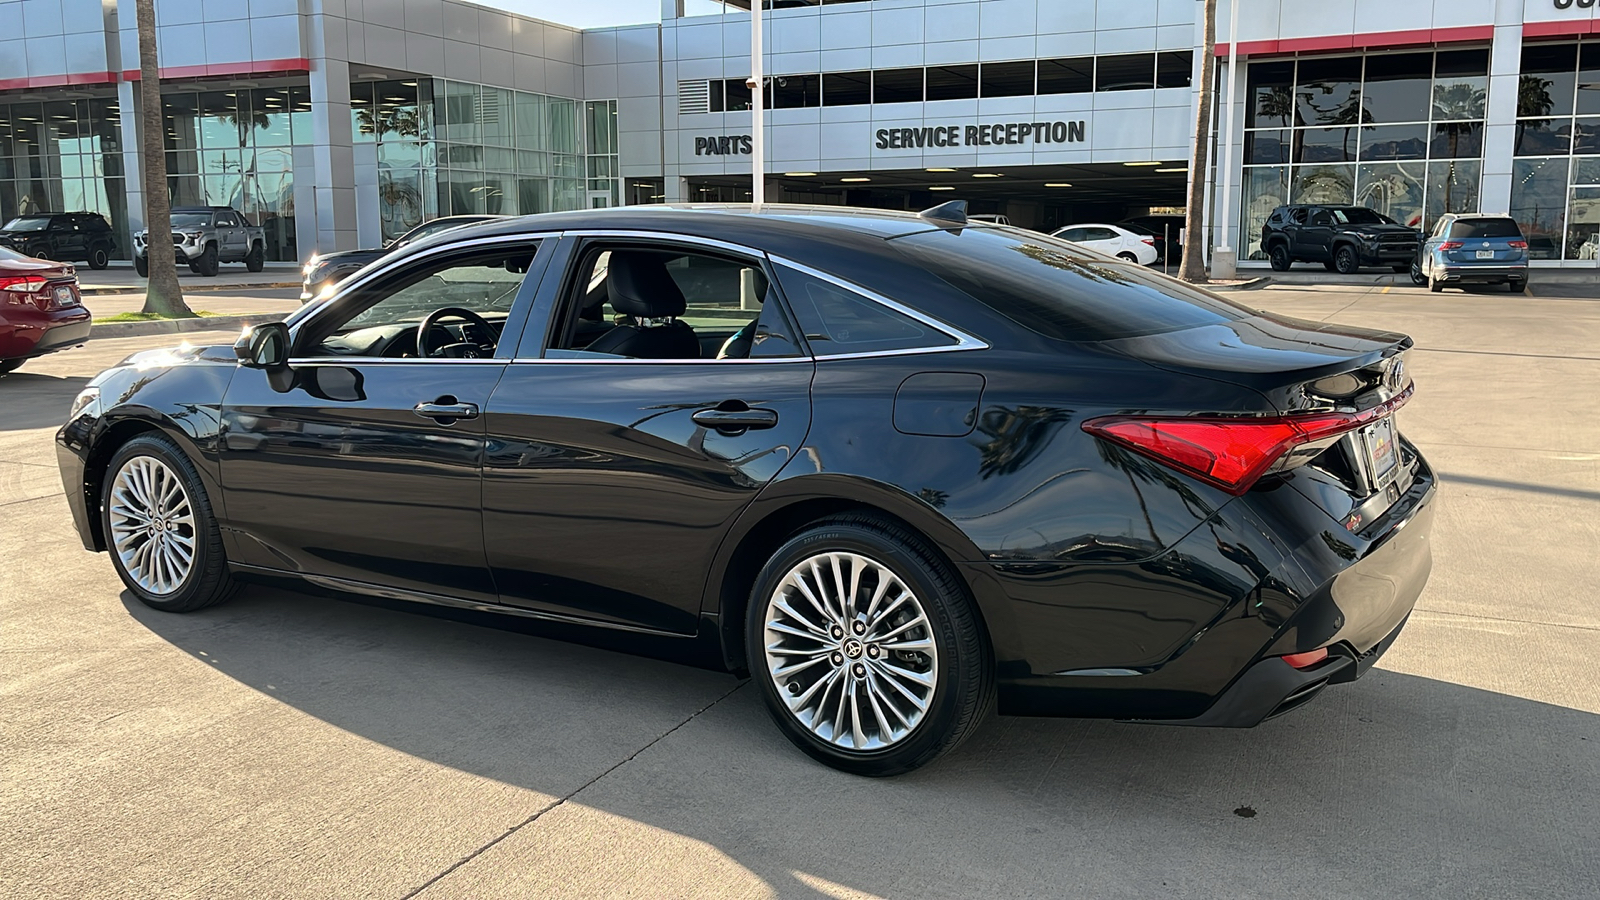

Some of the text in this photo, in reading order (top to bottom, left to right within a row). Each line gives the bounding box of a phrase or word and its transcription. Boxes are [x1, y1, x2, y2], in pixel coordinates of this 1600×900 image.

[694, 134, 753, 156] PARTS
[875, 120, 1086, 150] SERVICE RECEPTION
